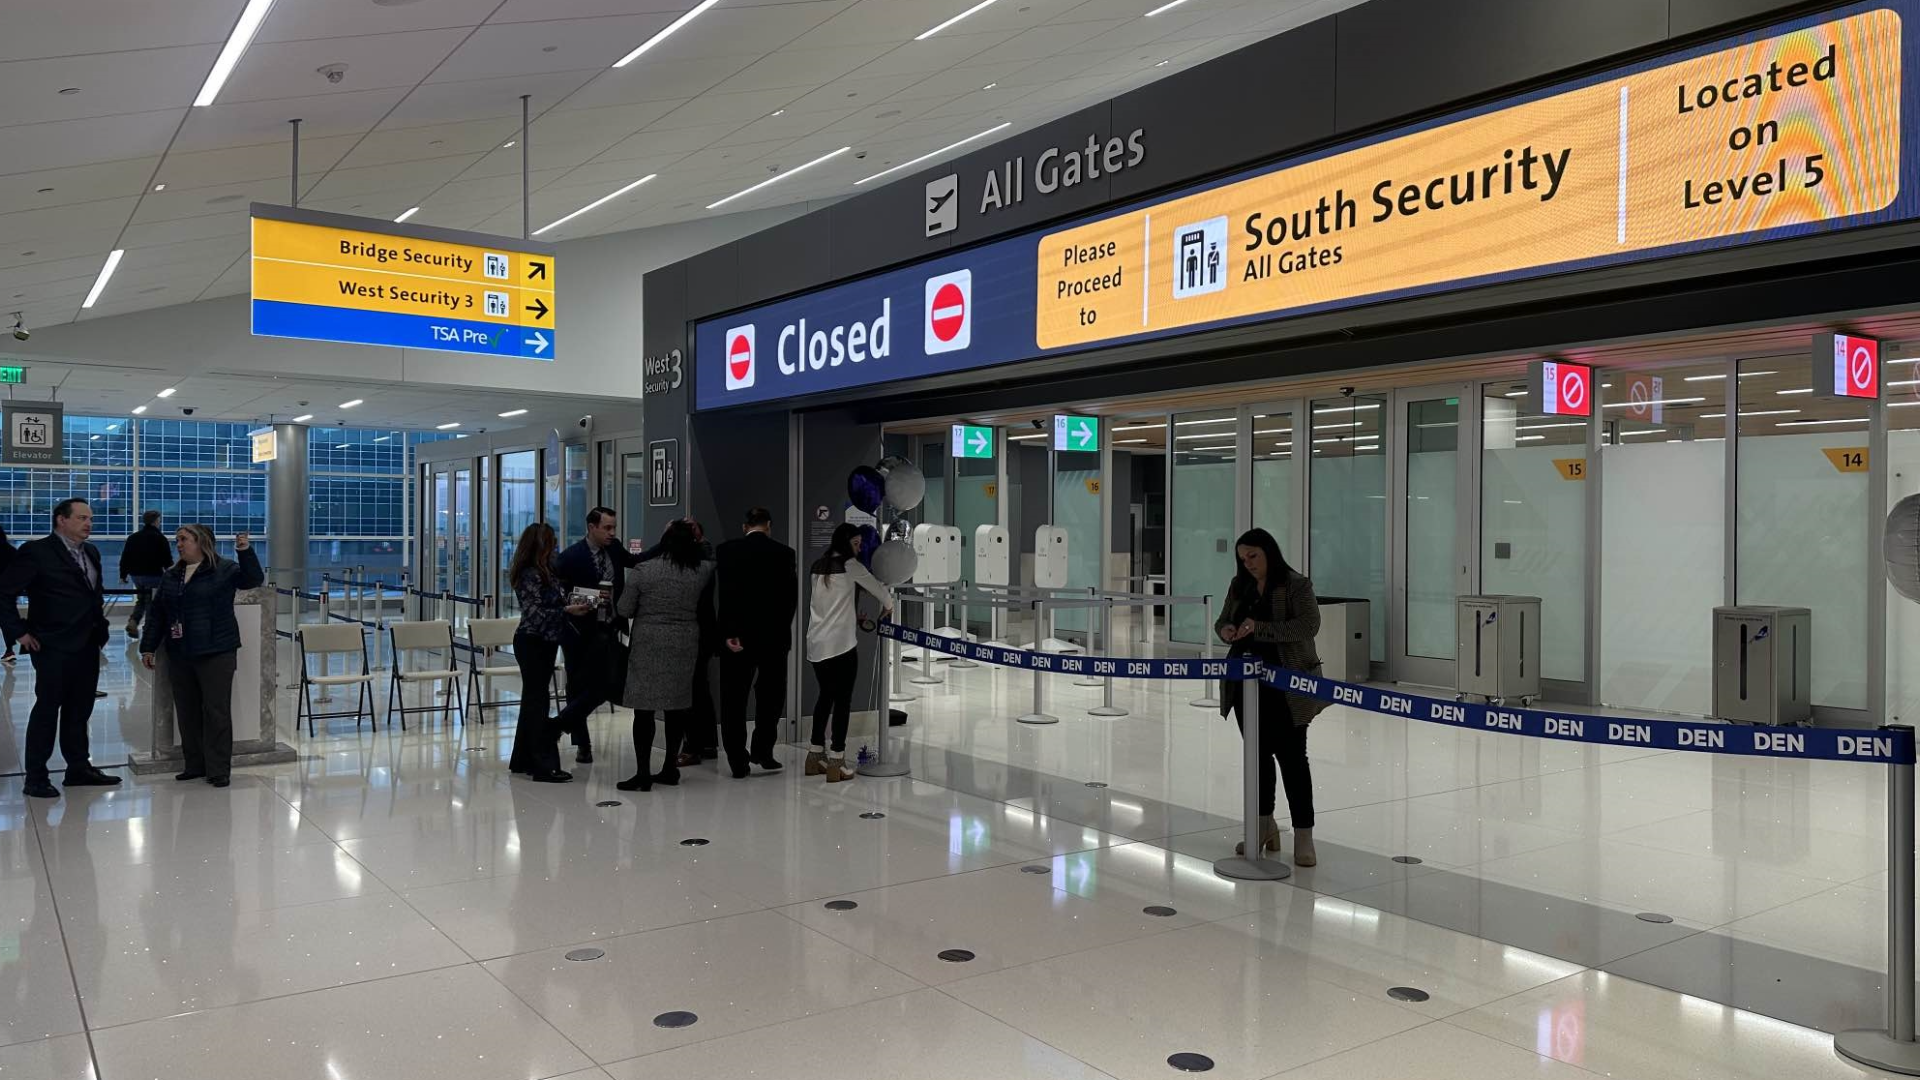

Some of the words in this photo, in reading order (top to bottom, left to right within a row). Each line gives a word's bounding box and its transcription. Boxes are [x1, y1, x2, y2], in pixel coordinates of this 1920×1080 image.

[1677, 44, 1838, 115] Located
[1728, 117, 1780, 152] on
[979, 157, 1022, 214] All
[1034, 128, 1145, 195] Gates
[1683, 163, 1789, 210] Level
[1803, 155, 1825, 187] 5
[1244, 190, 1358, 251] South
[1371, 144, 1573, 223] Security
[339, 240, 398, 263] Bridge
[403, 248, 473, 273] Security
[1063, 238, 1117, 268] Please
[1243, 252, 1274, 282] All
[1279, 242, 1344, 276] Gates
[338, 280, 384, 299] West
[390, 285, 460, 310] Security
[464, 294, 474, 308] 3
[1057, 266, 1122, 300] Proceed
[1079, 306, 1097, 327] to
[430, 325, 460, 343] TSA
[463, 329, 487, 346] Pre
[776, 297, 891, 376] Closed
[1835, 340, 1846, 357] 14
[1, 368, 22, 383] EXIT
[645, 353, 670, 376] West
[671, 349, 682, 389] 3
[1545, 367, 1555, 380] 15
[645, 379, 670, 394] Security
[954, 428, 963, 437] 17
[1056, 418, 1066, 429] 16
[13, 451, 52, 460] Elevator
[1568, 463, 1582, 476] 15
[1842, 453, 1863, 467] 14
[988, 486, 995, 494] 17
[1091, 483, 1099, 491] 16
[880, 622, 895, 635] DEN
[903, 630, 917, 642] DEN
[926, 637, 941, 650] DEN
[951, 642, 966, 654] DEN
[977, 648, 993, 659] DEN
[1004, 652, 1021, 664] DEN
[1032, 656, 1050, 668] DEN
[1062, 659, 1082, 671] DEN
[1095, 662, 1115, 673] DEN
[1128, 663, 1150, 674] DEN
[1164, 664, 1187, 675] DEN
[1203, 663, 1227, 675] DEN
[1243, 661, 1263, 675] DE
[1290, 676, 1317, 693] DEN
[1333, 686, 1362, 704] DEN
[1380, 695, 1411, 713] DEN
[1431, 704, 1464, 722] DEN
[1486, 711, 1521, 730] DEN
[1545, 718, 1583, 736] DEN
[1609, 724, 1650, 742] DEN
[1679, 728, 1724, 747] DEN
[1754, 733, 1804, 752] DEN
[1838, 736, 1891, 756] DEN
